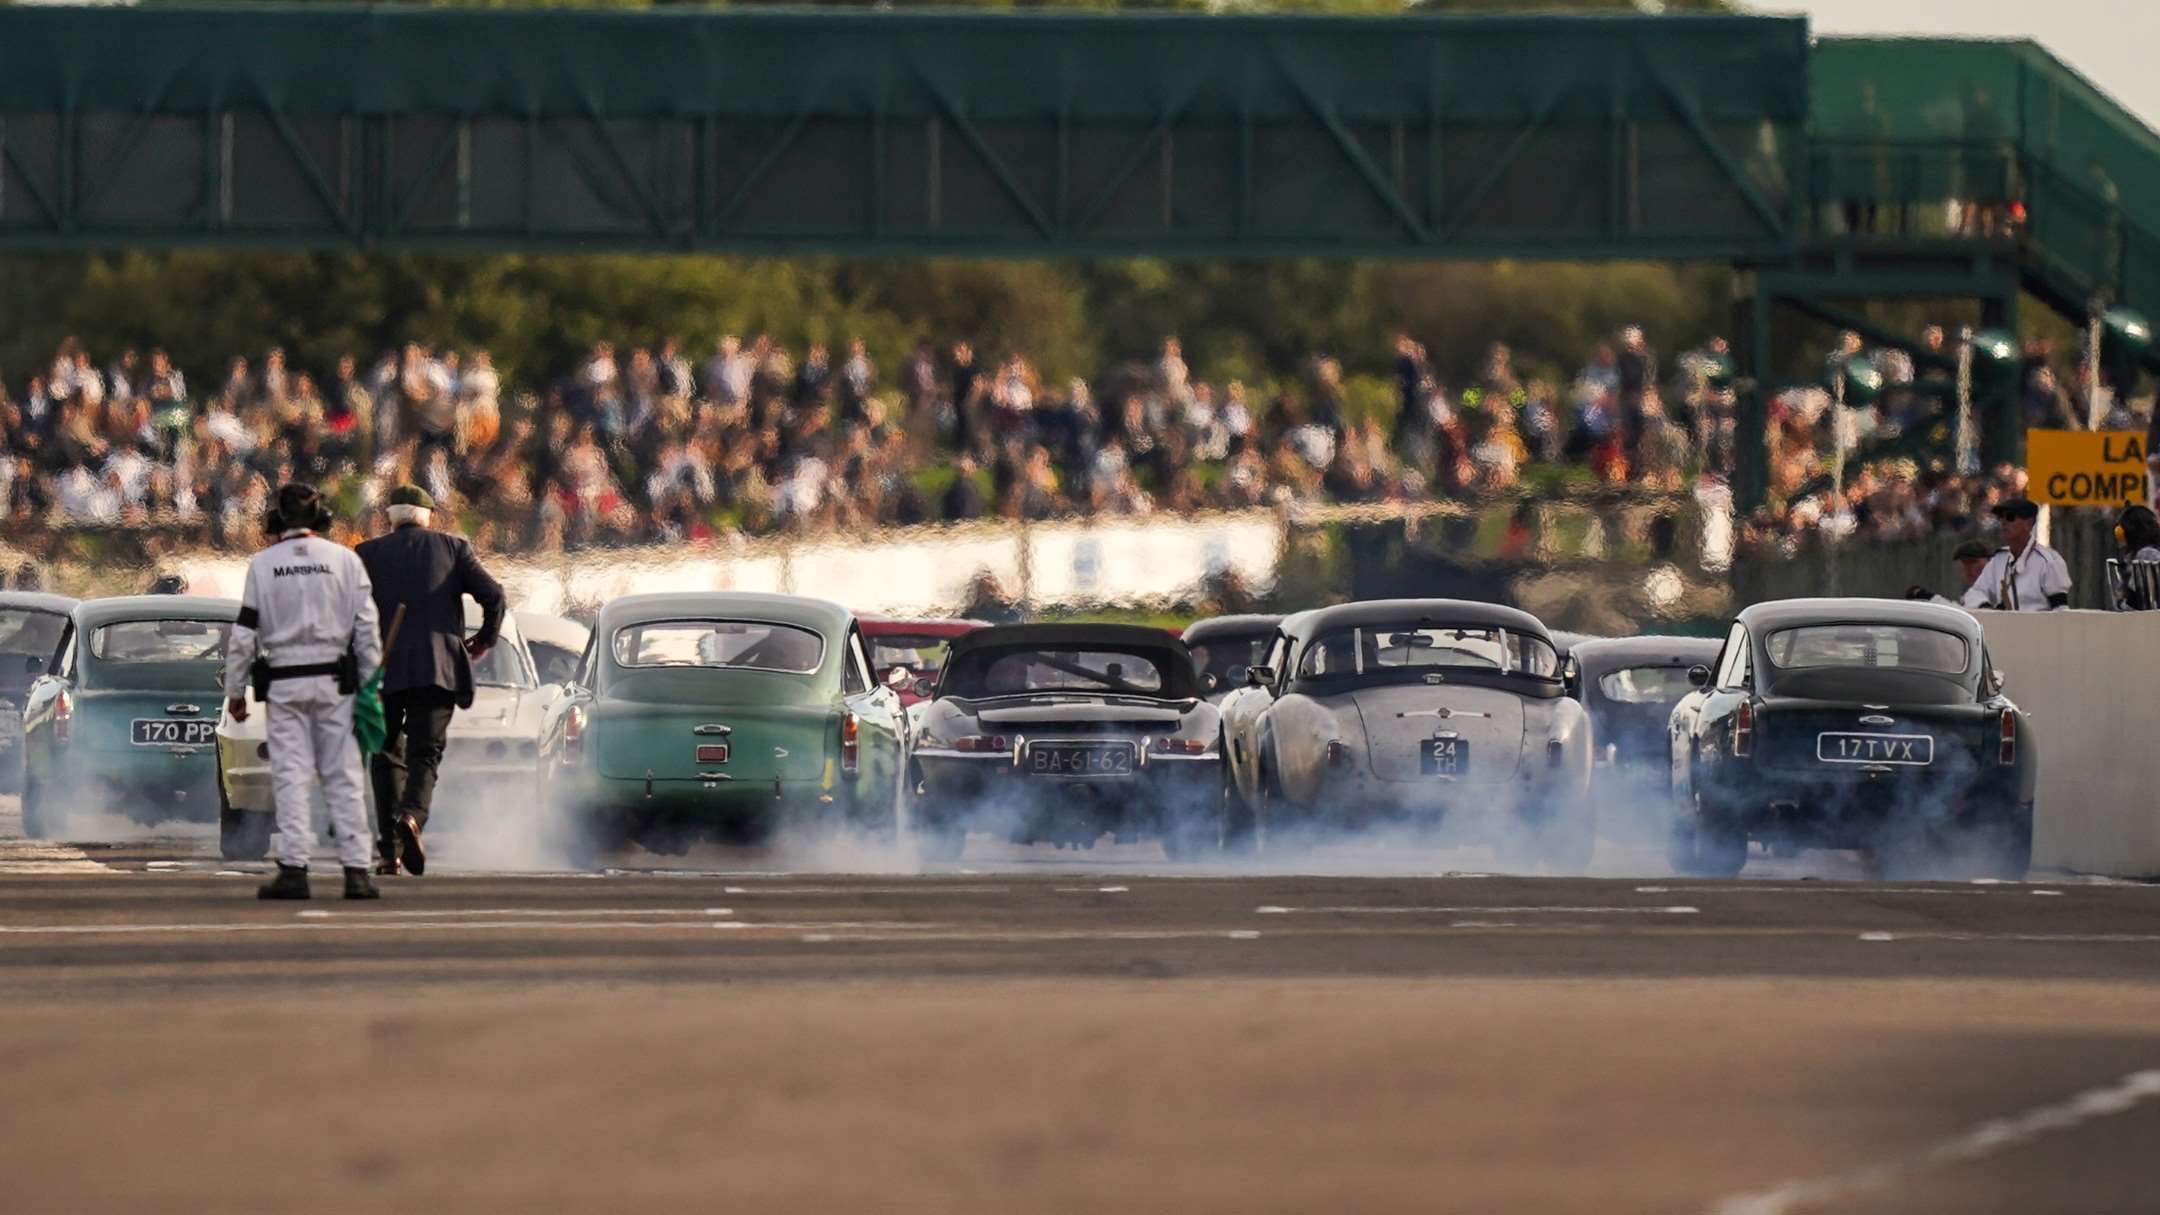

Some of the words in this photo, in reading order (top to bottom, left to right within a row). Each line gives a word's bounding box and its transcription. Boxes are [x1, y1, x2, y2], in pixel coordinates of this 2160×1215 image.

[2102, 436, 2144, 463] LA
[273, 562, 334, 579] MARSHAL
[142, 723, 180, 741] 170
[1433, 741, 1456, 757] 24
[1034, 750, 1127, 770] BA-61-62
